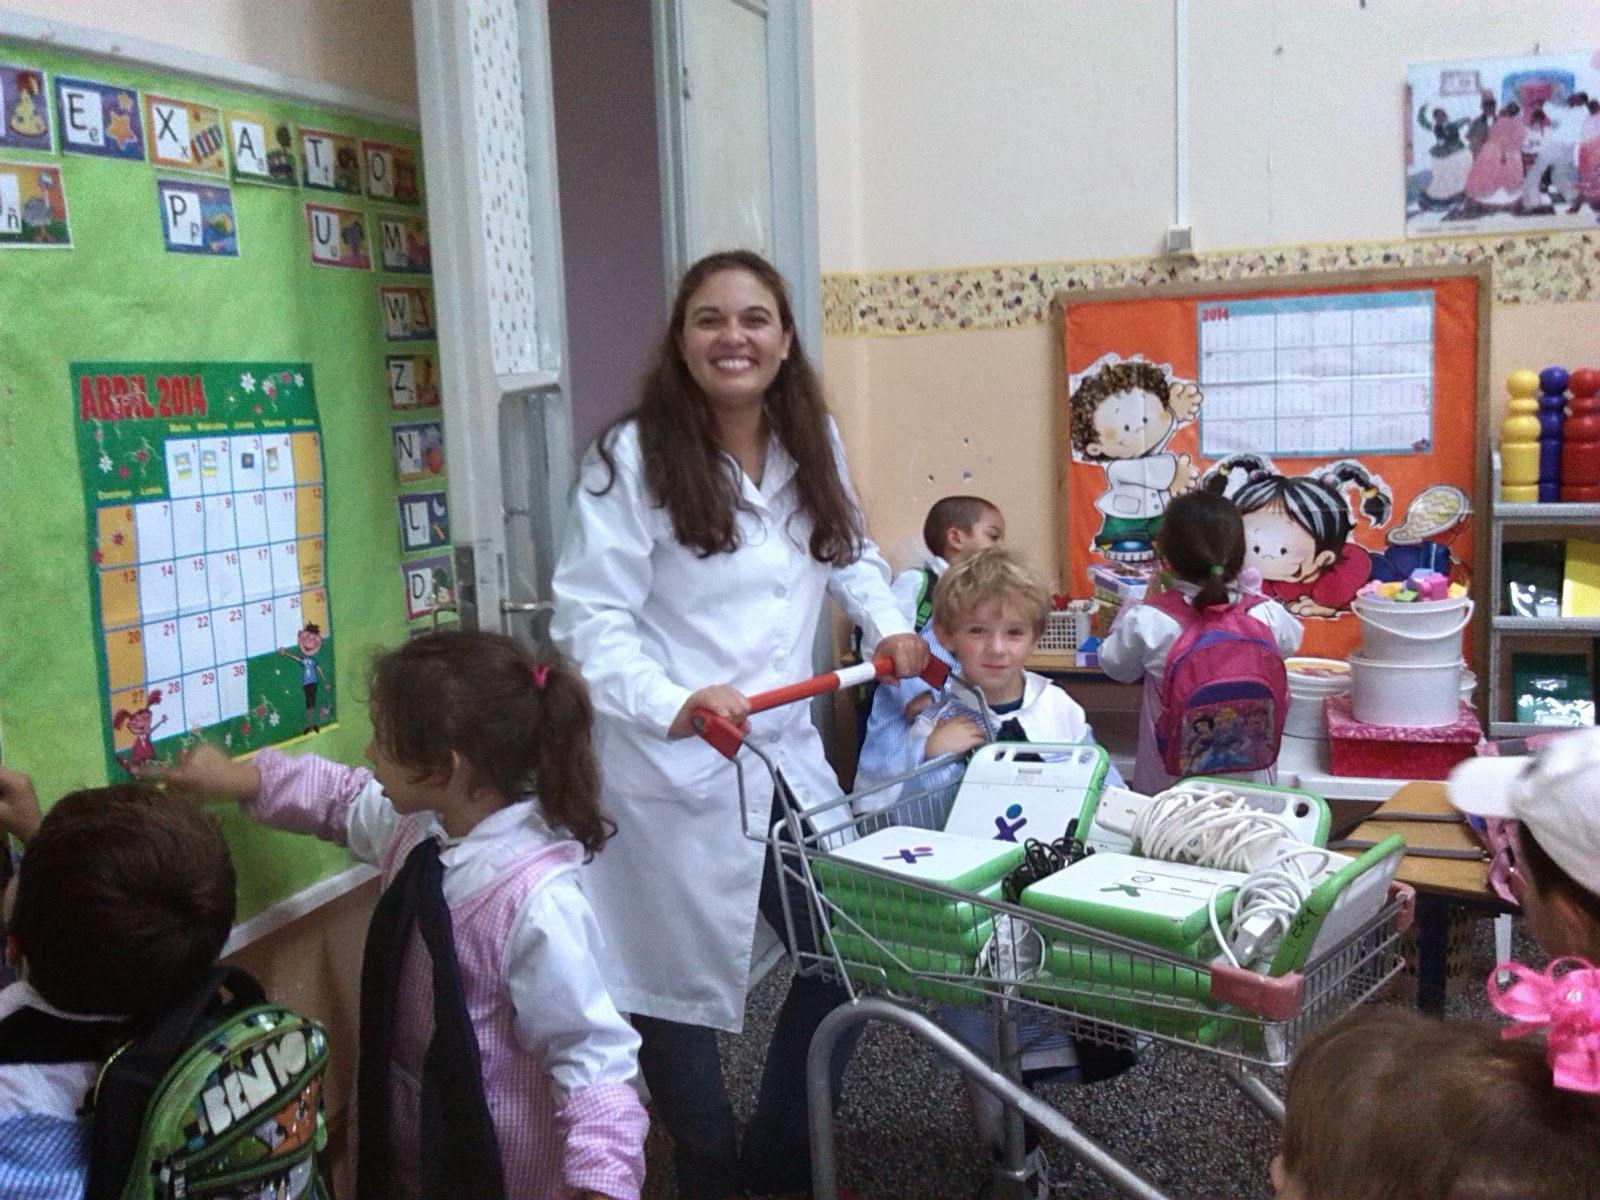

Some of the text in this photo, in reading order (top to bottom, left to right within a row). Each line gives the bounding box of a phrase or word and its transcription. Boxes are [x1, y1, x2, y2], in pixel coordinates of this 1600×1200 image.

[68, 93, 87, 130] E
[156, 107, 178, 142] X
[238, 126, 257, 160] A
[307, 138, 322, 167] T
[371, 152, 385, 182] O
[169, 194, 200, 242] P p
[314, 214, 332, 245] U
[383, 223, 401, 250] M
[387, 296, 407, 320] W
[1201, 307, 1228, 321] 2014
[392, 363, 407, 390] Z
[79, 374, 207, 421] ABRIL 2014
[399, 433, 413, 460] N
[409, 505, 420, 530] L
[412, 573, 425, 600] D
[197, 615, 209, 628] 22
[230, 609, 242, 622] 23
[261, 603, 271, 615] 24
[202, 672, 214, 685] 29
[233, 664, 245, 677] 30
[202, 1030, 307, 1136] BEN 10
